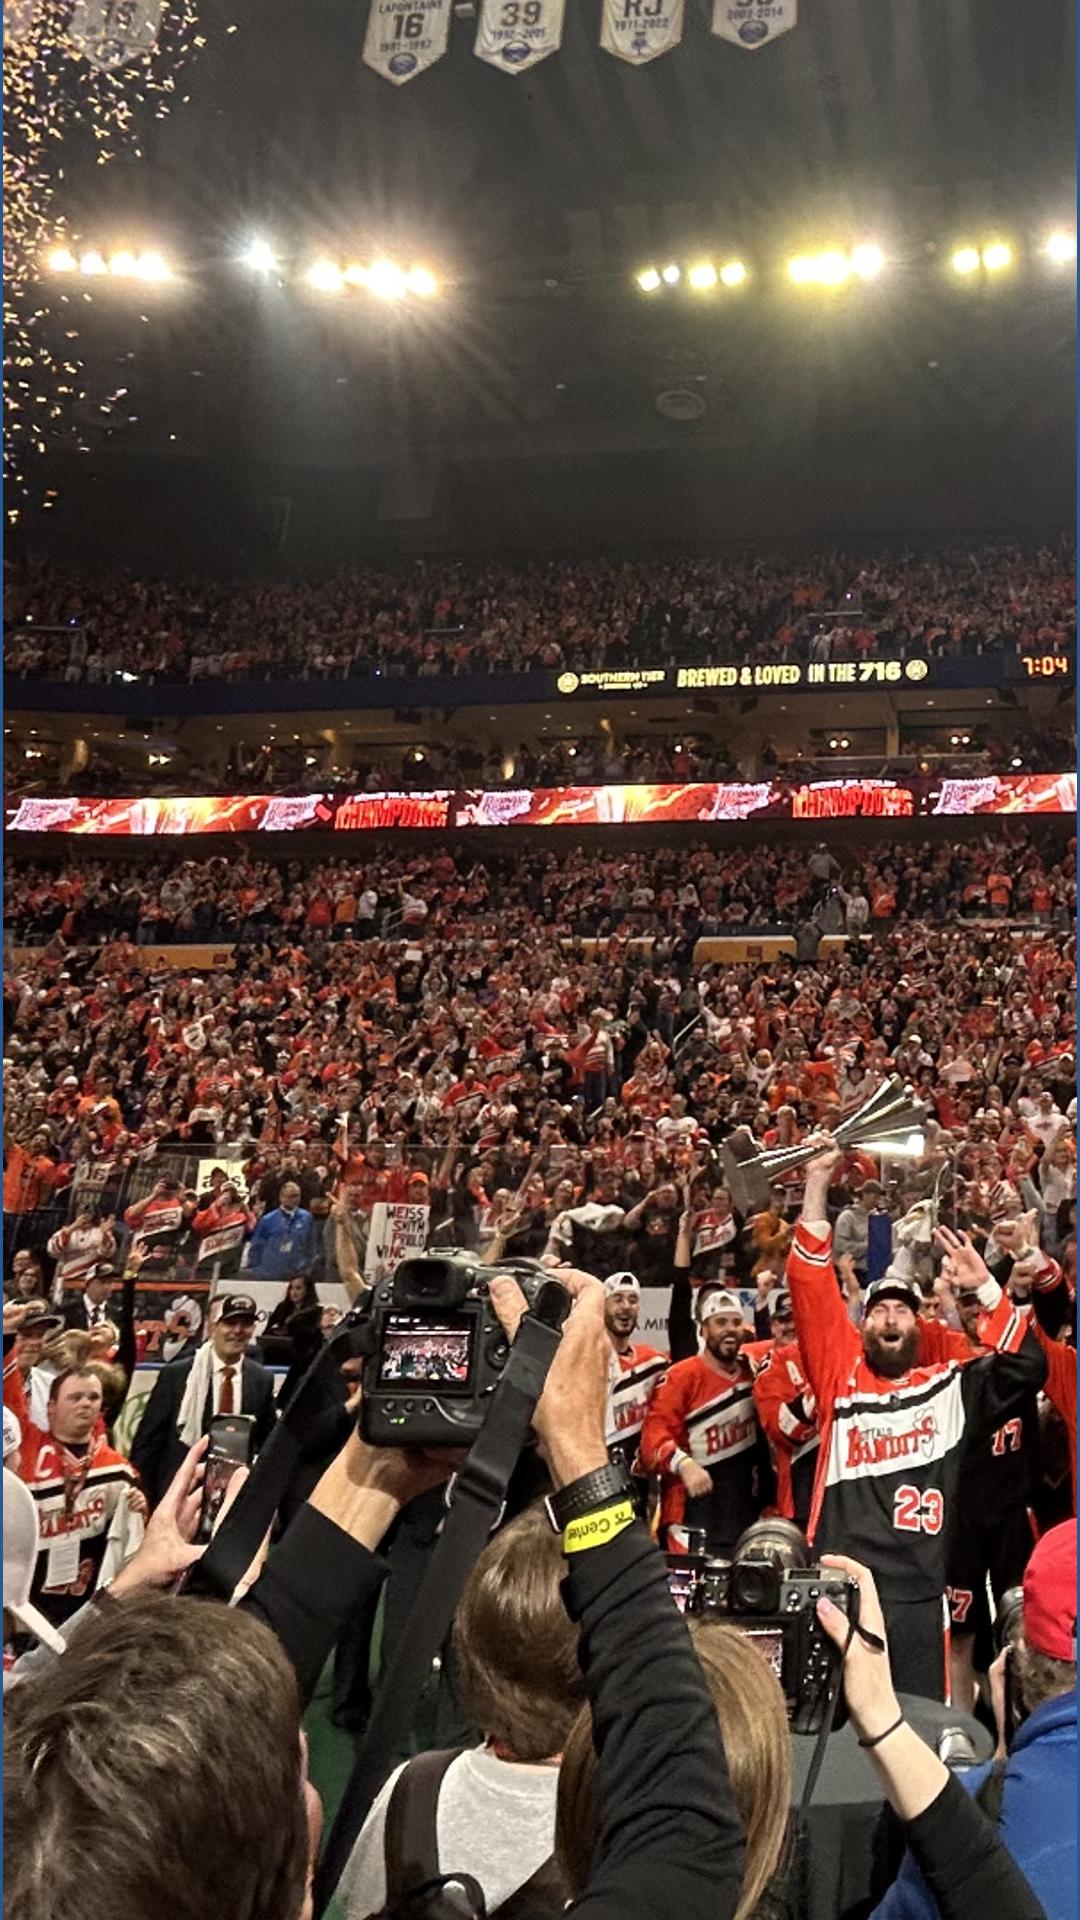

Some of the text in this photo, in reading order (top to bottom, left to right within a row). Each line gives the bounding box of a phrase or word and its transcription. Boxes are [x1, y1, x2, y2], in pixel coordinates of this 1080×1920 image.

[500, 1, 542, 26] 39
[624, 0, 663, 17] RJ
[393, 13, 425, 39] 16
[581, 670, 665, 684] SOUTHERN TIER
[677, 661, 901, 688] BREWED & LOVED IN THE 716
[1022, 656, 1068, 675] 7:04
[334, 799, 449, 830] CHAMPIONS
[386, 1205, 425, 1220] WEISS
[392, 1220, 425, 1233] SMITH
[35, 1444, 56, 1478] C
[894, 1484, 944, 1535] 23
